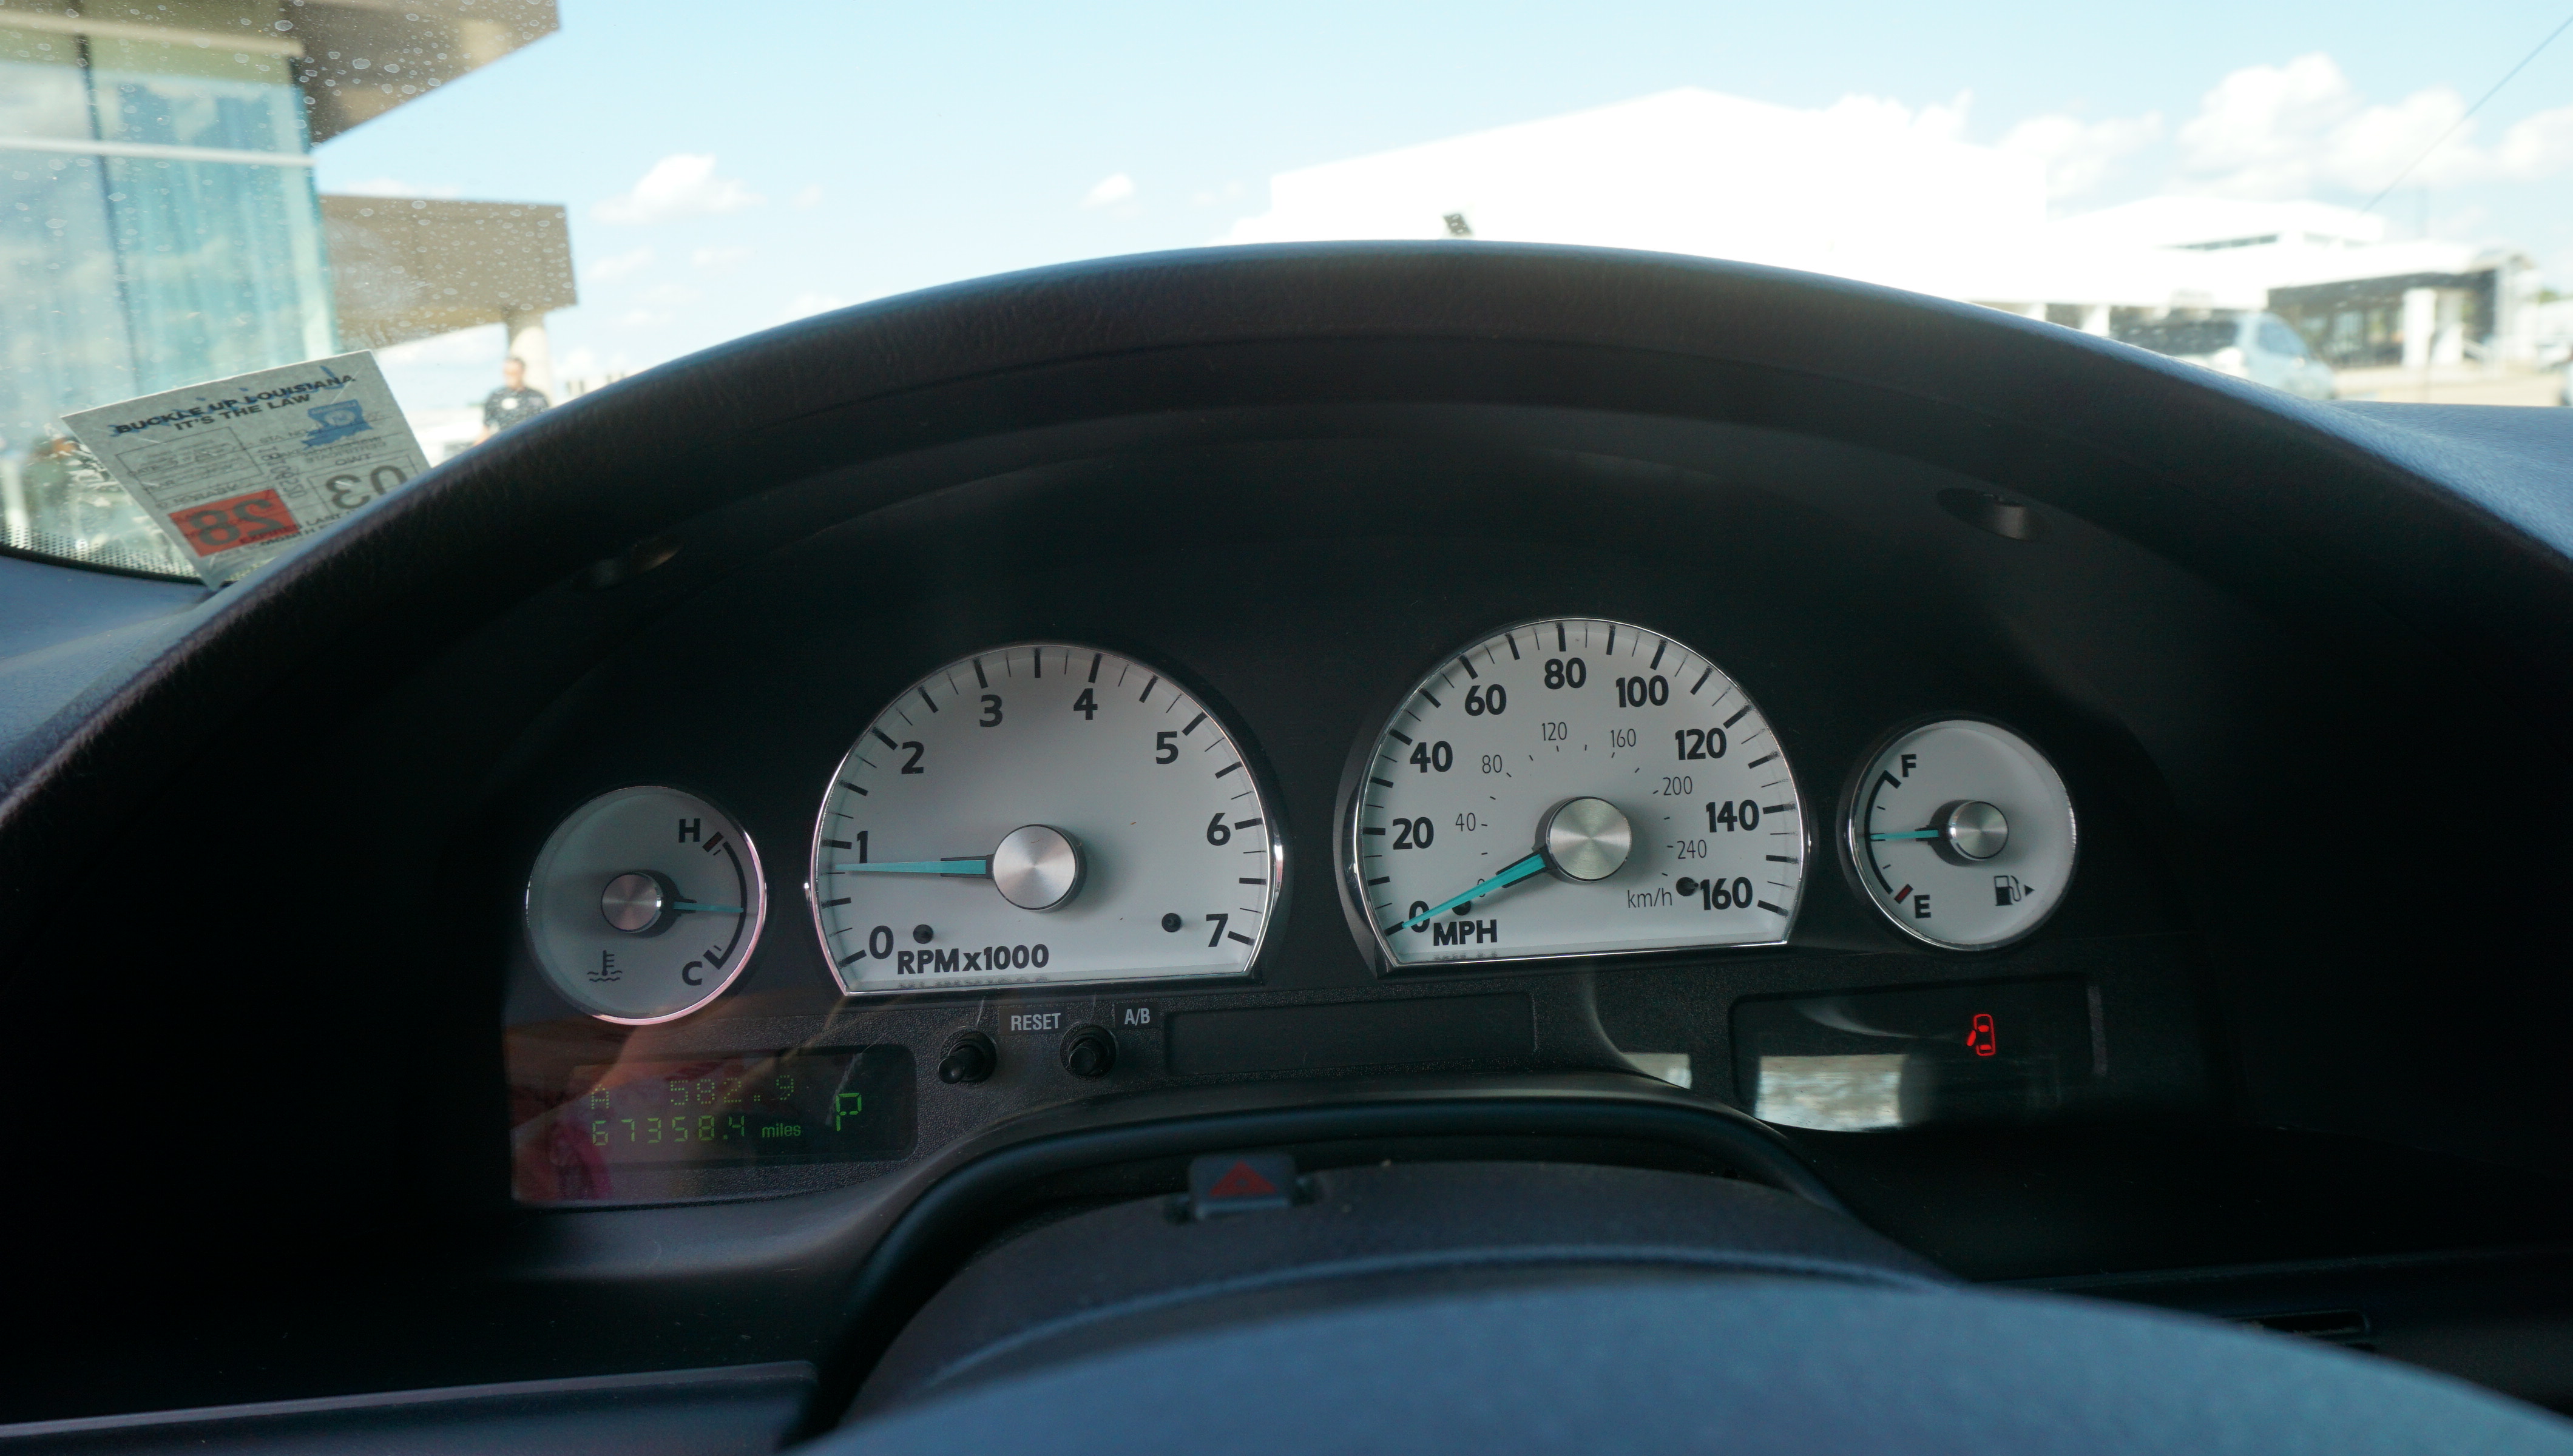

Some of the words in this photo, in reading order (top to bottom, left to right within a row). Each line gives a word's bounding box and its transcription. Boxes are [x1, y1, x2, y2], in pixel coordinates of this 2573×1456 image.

[115, 406, 204, 434] BUCKLE
[208, 399, 237, 411] UP
[174, 416, 215, 431] IT'S
[217, 405, 262, 419] THE
[267, 394, 311, 410] LAW
[1544, 658, 1586, 689] 80
[1073, 688, 1098, 720] 4
[1465, 684, 1506, 716] 60
[1616, 675, 1669, 707] 100
[979, 694, 1002, 727] 3
[1542, 722, 1567, 741] 120
[1611, 729, 1636, 747] 160
[1676, 729, 1726, 760] 120
[902, 741, 924, 774] 2
[1156, 731, 1178, 764] 5
[1410, 739, 1453, 773] 40
[1483, 755, 1502, 774] 80
[1901, 754, 1916, 777] F
[1663, 776, 1692, 795] 200
[678, 818, 700, 843] H
[1207, 813, 1230, 846] 6
[1456, 813, 1475, 831] 40
[1706, 800, 1759, 832] 140
[857, 831, 868, 862] 1
[1393, 817, 1433, 850] 20
[1677, 840, 1706, 859] 240
[1628, 888, 1672, 908] km/h
[1700, 877, 1753, 910] 160
[1915, 895, 1931, 918] E
[1206, 914, 1228, 947] 7
[1409, 901, 1430, 932] 0
[869, 926, 893, 959] 0
[1433, 920, 1497, 946] MPH
[682, 961, 702, 986] C
[1011, 1013, 1061, 1031] RESET
[1124, 1008, 1150, 1025] A/B
[591, 1084, 609, 1110] A
[670, 1075, 794, 1105] 582.9
[836, 1093, 862, 1131] P
[592, 1115, 745, 1145] 67358.4
[762, 1122, 801, 1138] miles
